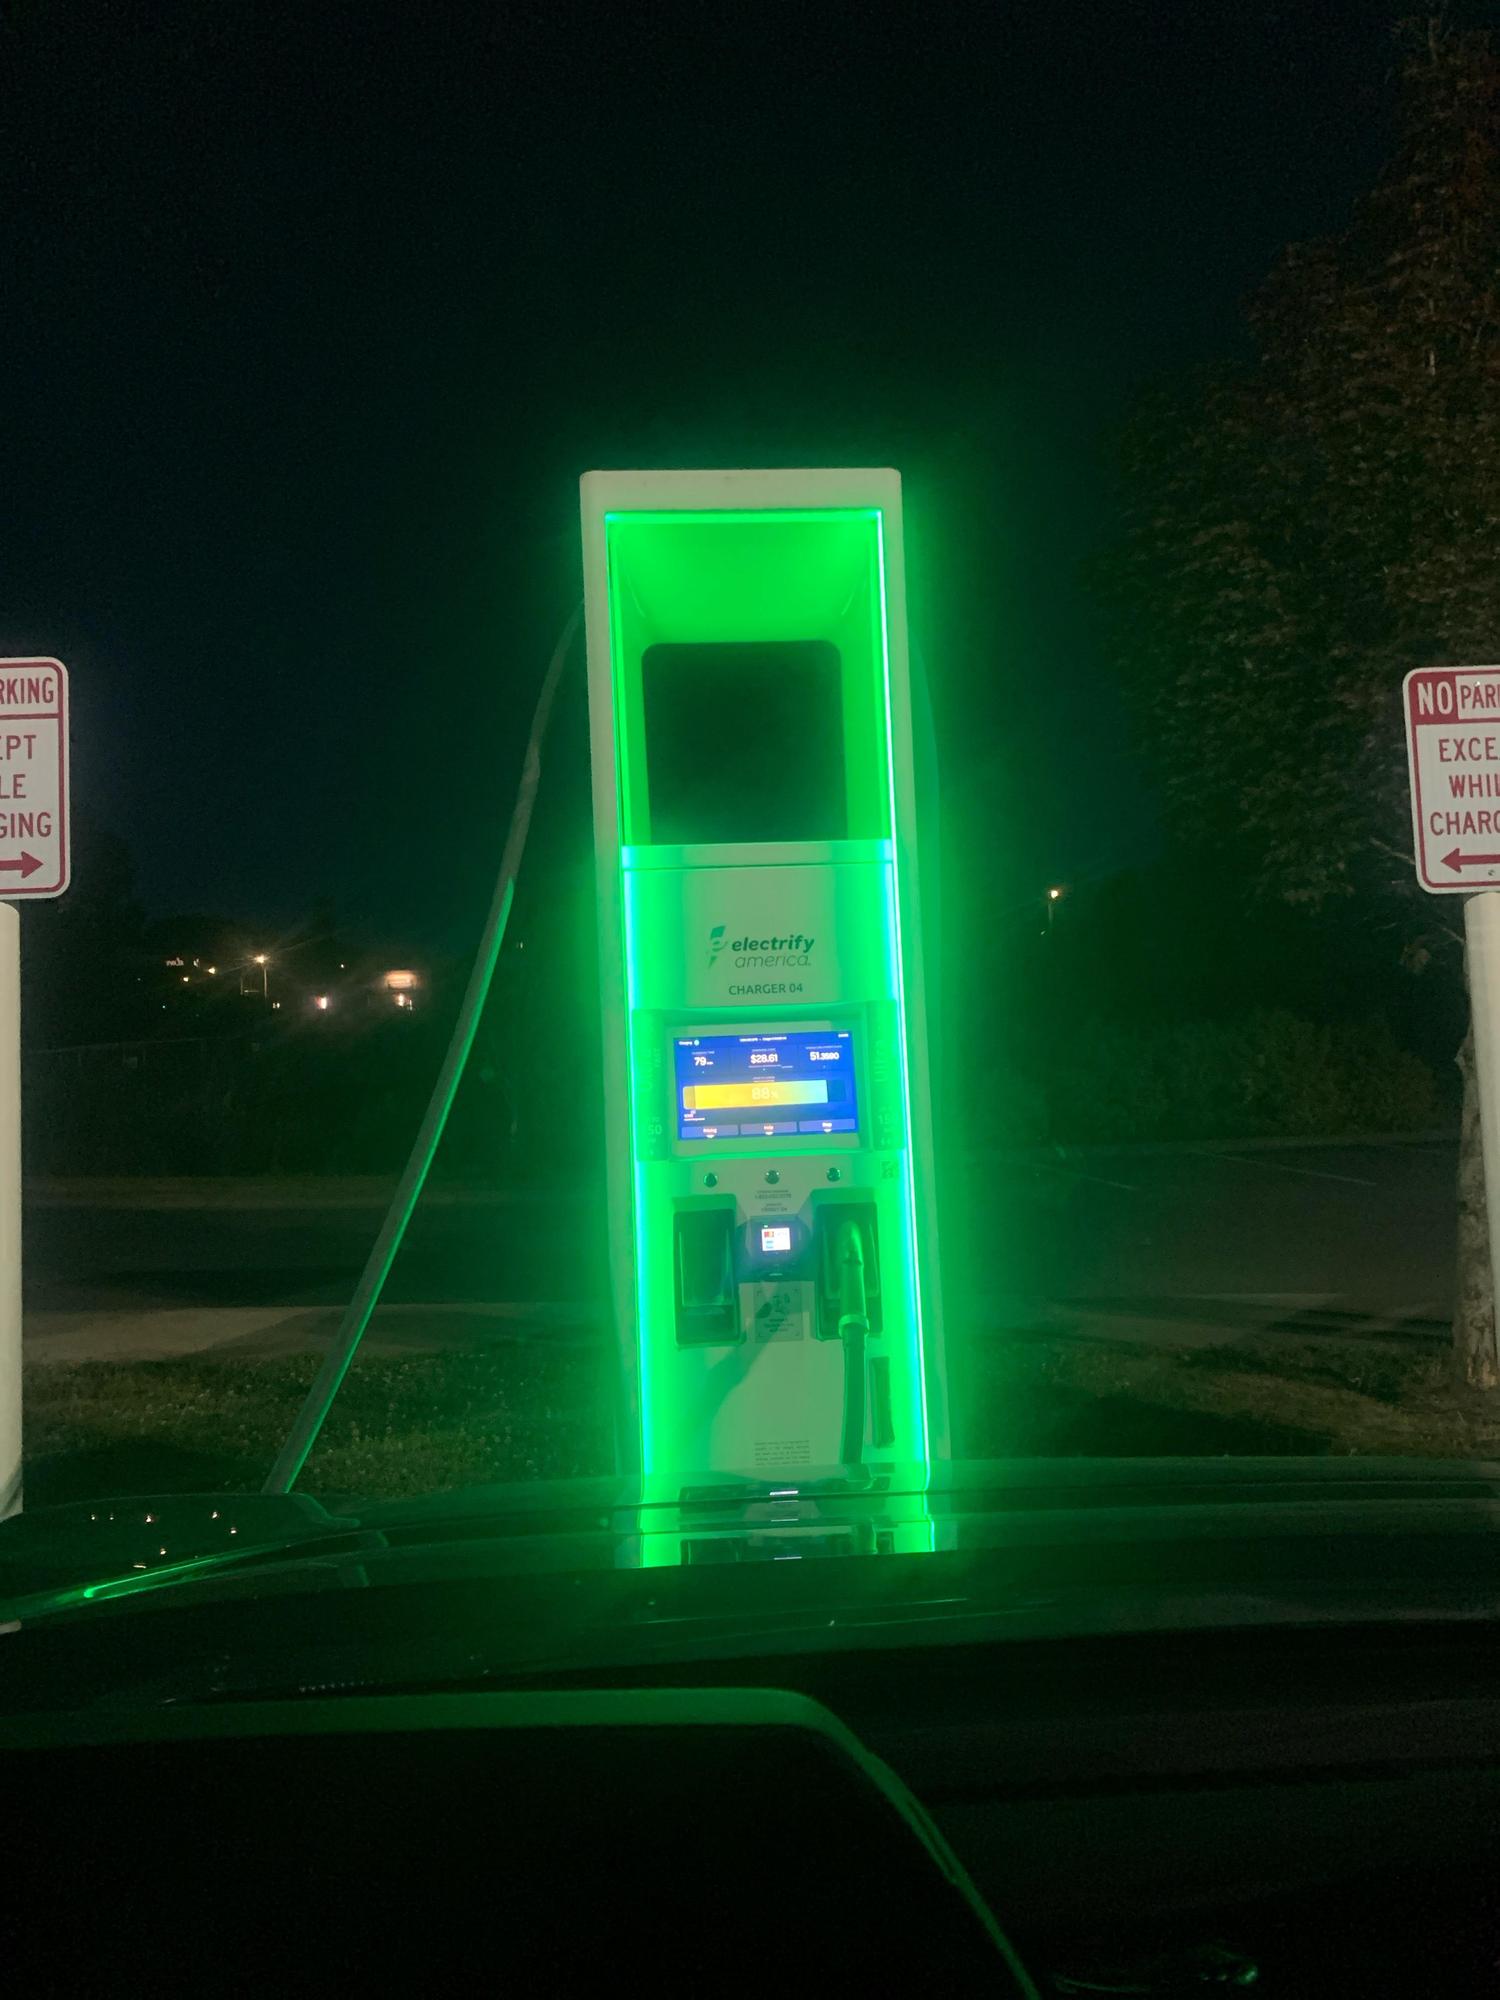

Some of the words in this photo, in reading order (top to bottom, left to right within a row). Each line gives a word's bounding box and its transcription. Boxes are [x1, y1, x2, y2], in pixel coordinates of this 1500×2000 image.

[1417, 681, 1453, 715] NO
[1460, 684, 1500, 709] PAR
[0, 735, 36, 760] PT
[0, 774, 26, 799] LE
[1449, 773, 1500, 798] WHIL
[731, 933, 815, 954] electrify
[728, 983, 786, 996] CHARGER
[789, 983, 804, 993] 04
[750, 1053, 778, 1064] $28.61
